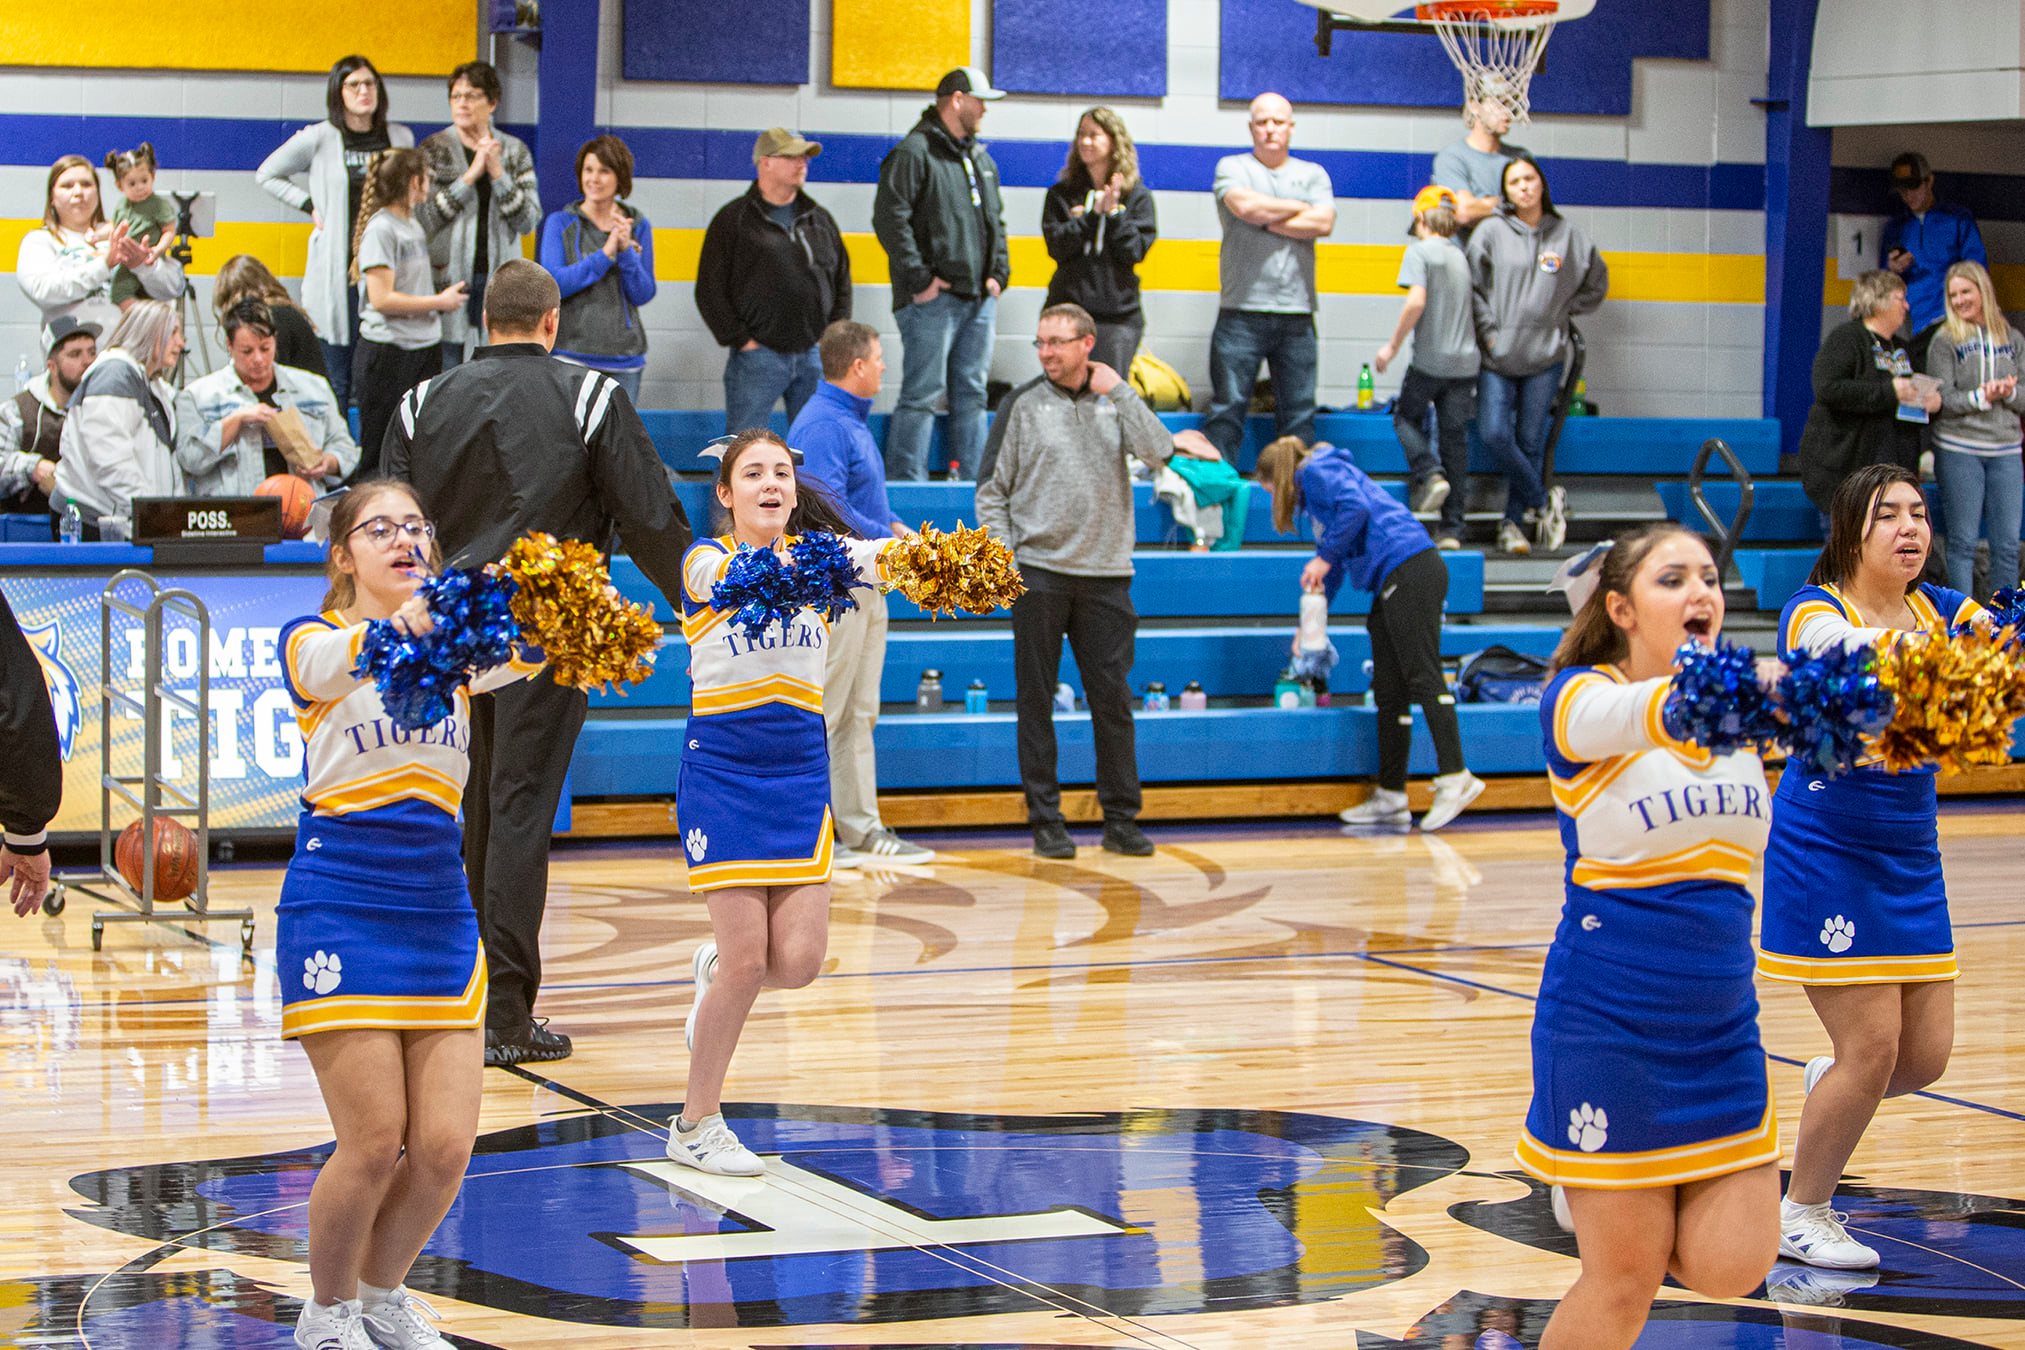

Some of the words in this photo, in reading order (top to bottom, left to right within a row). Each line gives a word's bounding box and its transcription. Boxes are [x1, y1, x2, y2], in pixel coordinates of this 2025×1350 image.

[1852, 230, 1862, 256] 1
[187, 510, 232, 529] POSS.
[723, 624, 823, 657] TIGERS
[125, 689, 303, 778] TIG
[345, 718, 468, 755] TIGERS
